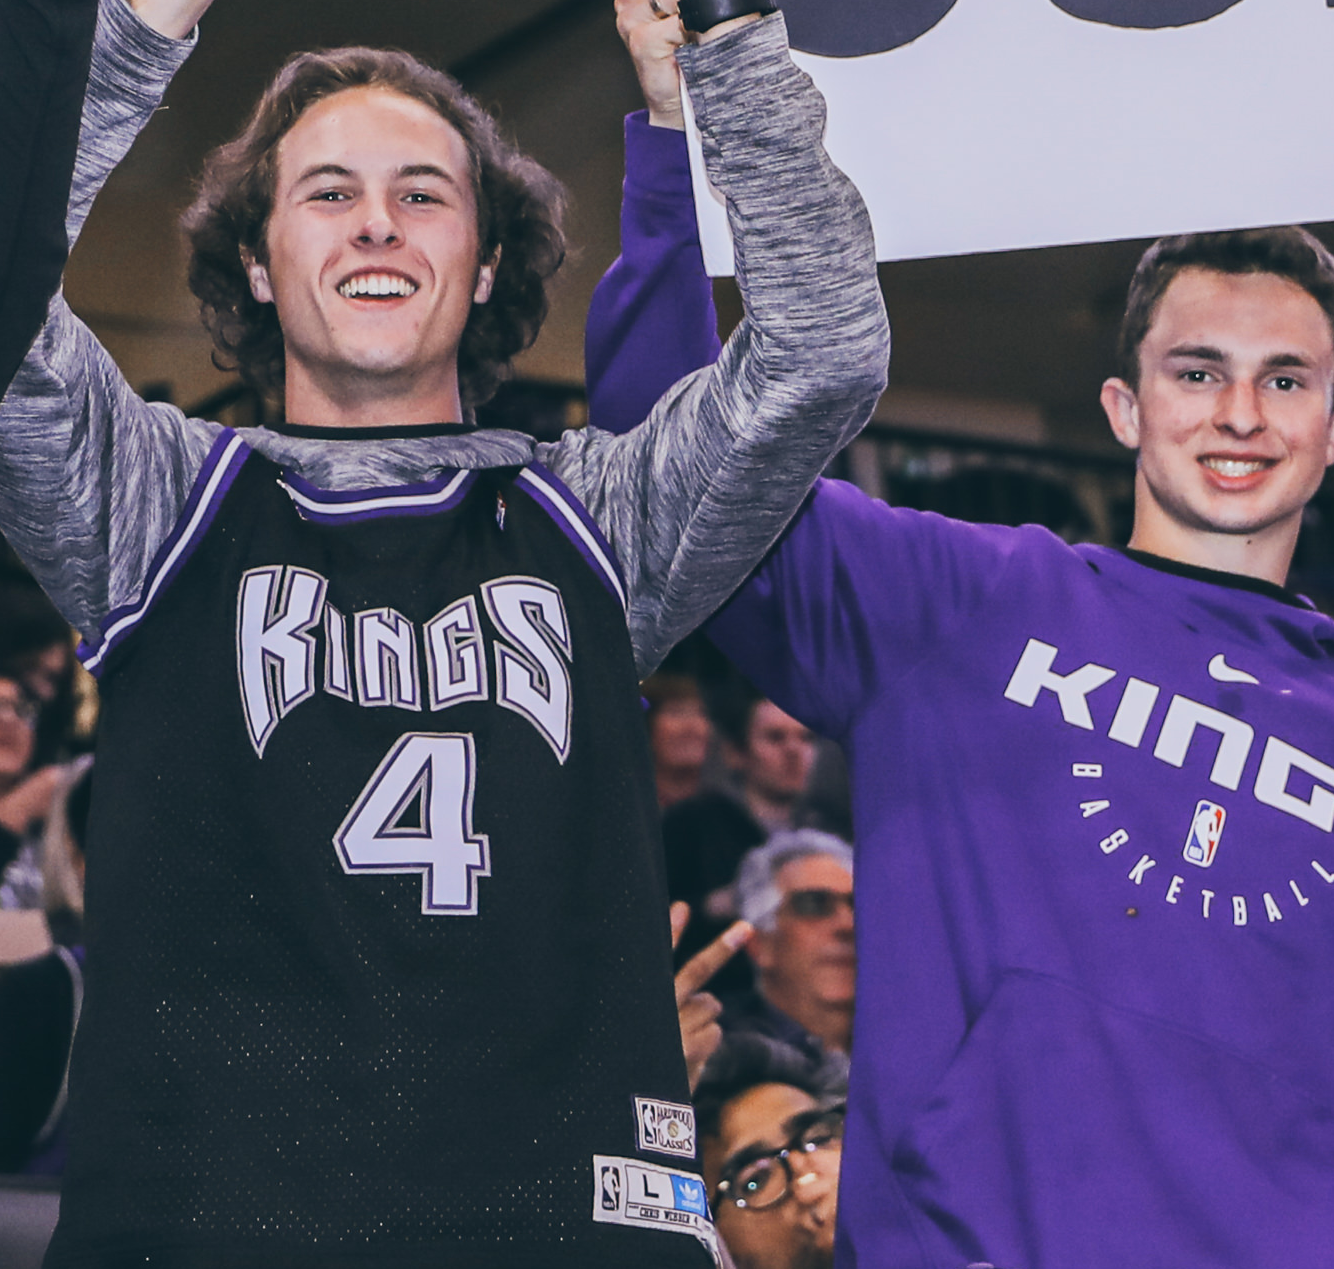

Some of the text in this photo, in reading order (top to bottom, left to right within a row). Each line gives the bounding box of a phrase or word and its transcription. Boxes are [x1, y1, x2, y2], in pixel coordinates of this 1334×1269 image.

[236, 565, 573, 765] KINGS
[332, 731, 491, 916] 4
[642, 1174, 659, 1199] L
